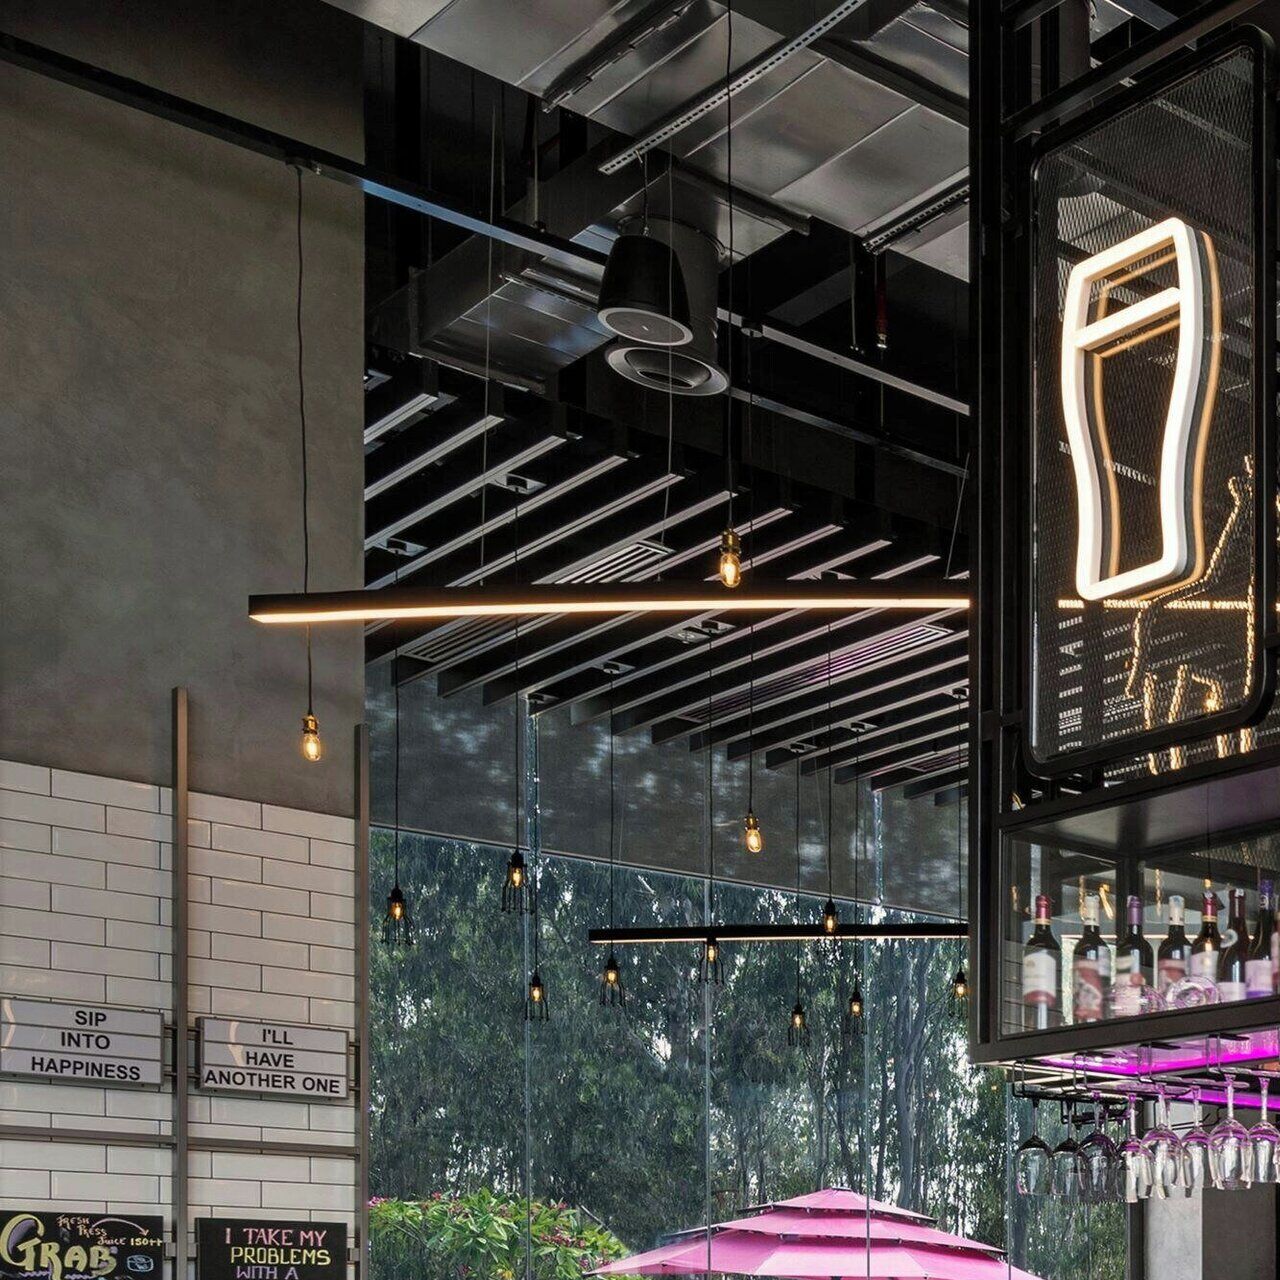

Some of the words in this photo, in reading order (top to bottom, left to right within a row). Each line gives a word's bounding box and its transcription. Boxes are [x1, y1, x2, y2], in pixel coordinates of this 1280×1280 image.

[75, 1010, 107, 1027] SIP
[60, 1032, 111, 1050] INTO
[262, 1029, 294, 1045] I'LL
[31, 1056, 141, 1081] HAPPINESS
[246, 1051, 295, 1068] HAVE
[204, 1069, 296, 1090] ANOTHER
[302, 1077, 340, 1094] ONE
[225, 1228, 231, 1244] I
[243, 1228, 293, 1246] TAKE
[300, 1229, 327, 1247] MY
[230, 1246, 331, 1266] PROBLEMS
[236, 1265, 278, 1280] WITH
[284, 1266, 299, 1280] A
